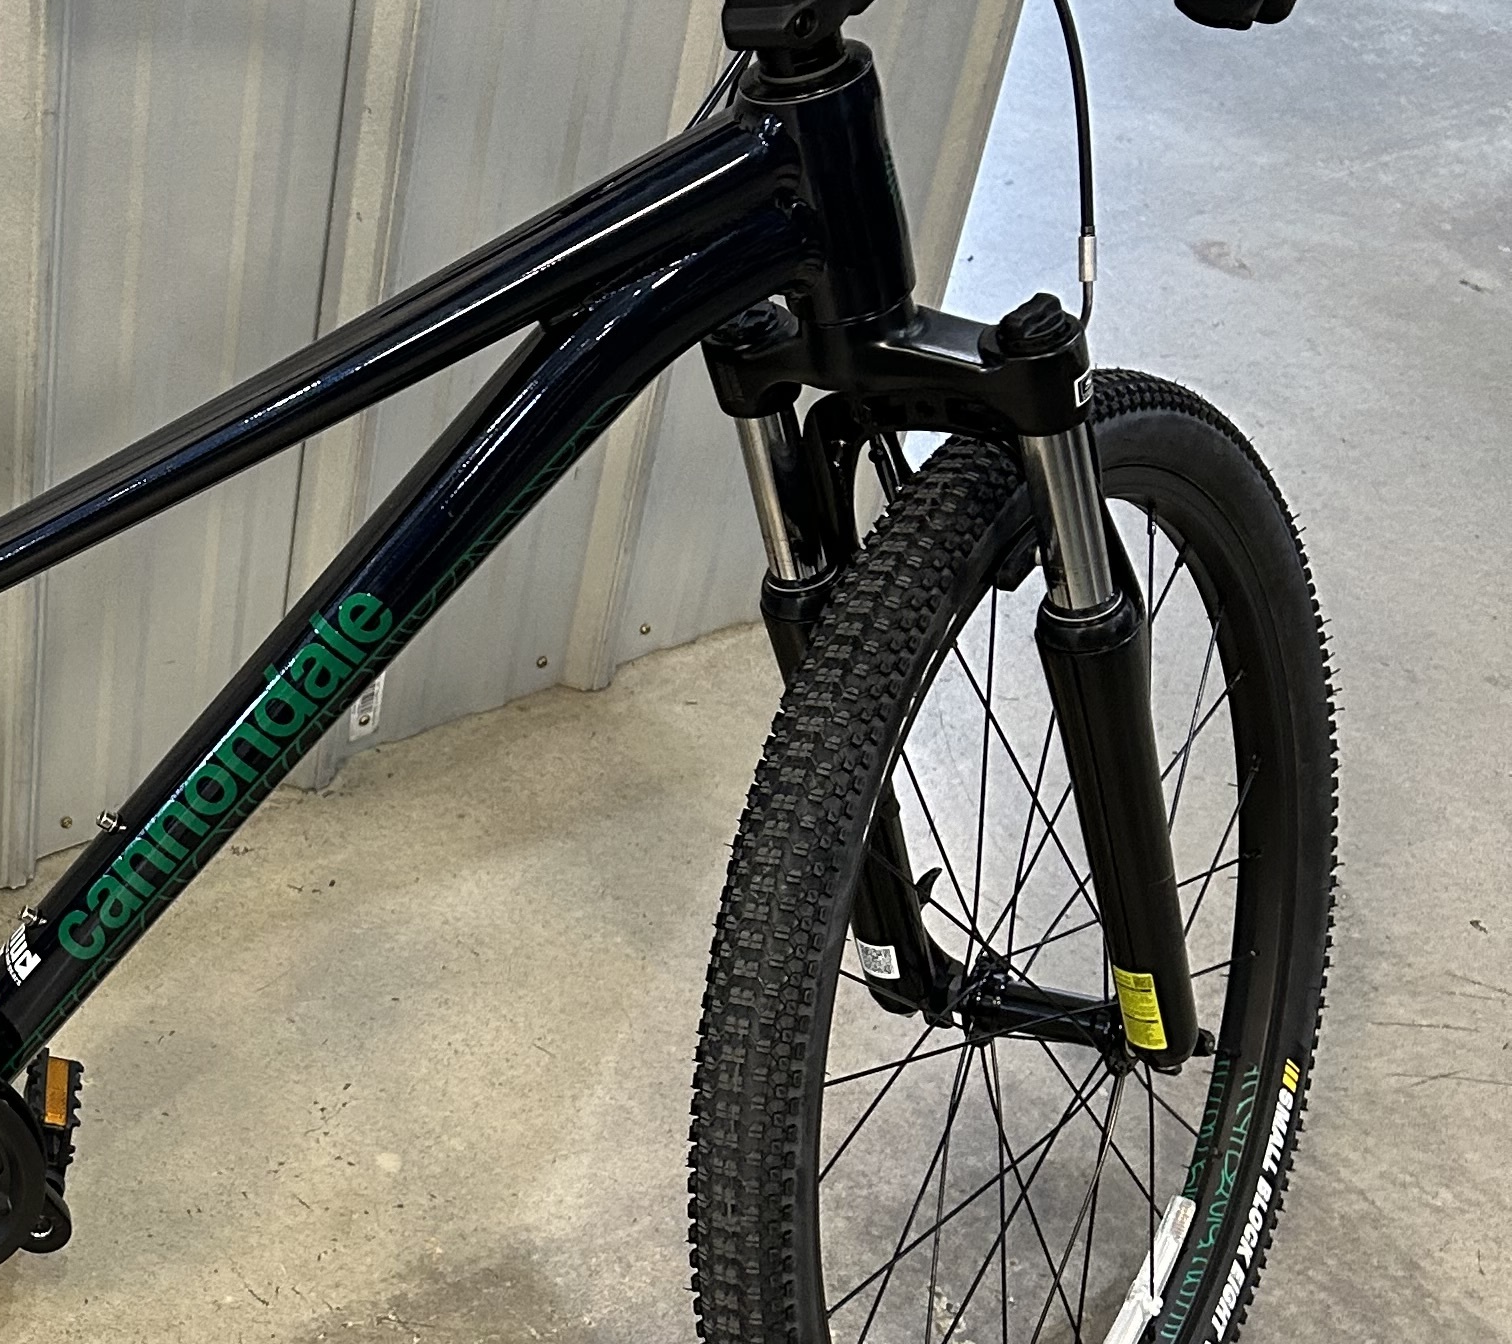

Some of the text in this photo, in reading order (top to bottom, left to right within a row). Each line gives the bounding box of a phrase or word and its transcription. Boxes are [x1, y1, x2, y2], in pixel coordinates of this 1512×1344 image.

[58, 593, 392, 960] cannondale
[1210, 1087, 1294, 1342] SMALL BLOCK EIGHT
